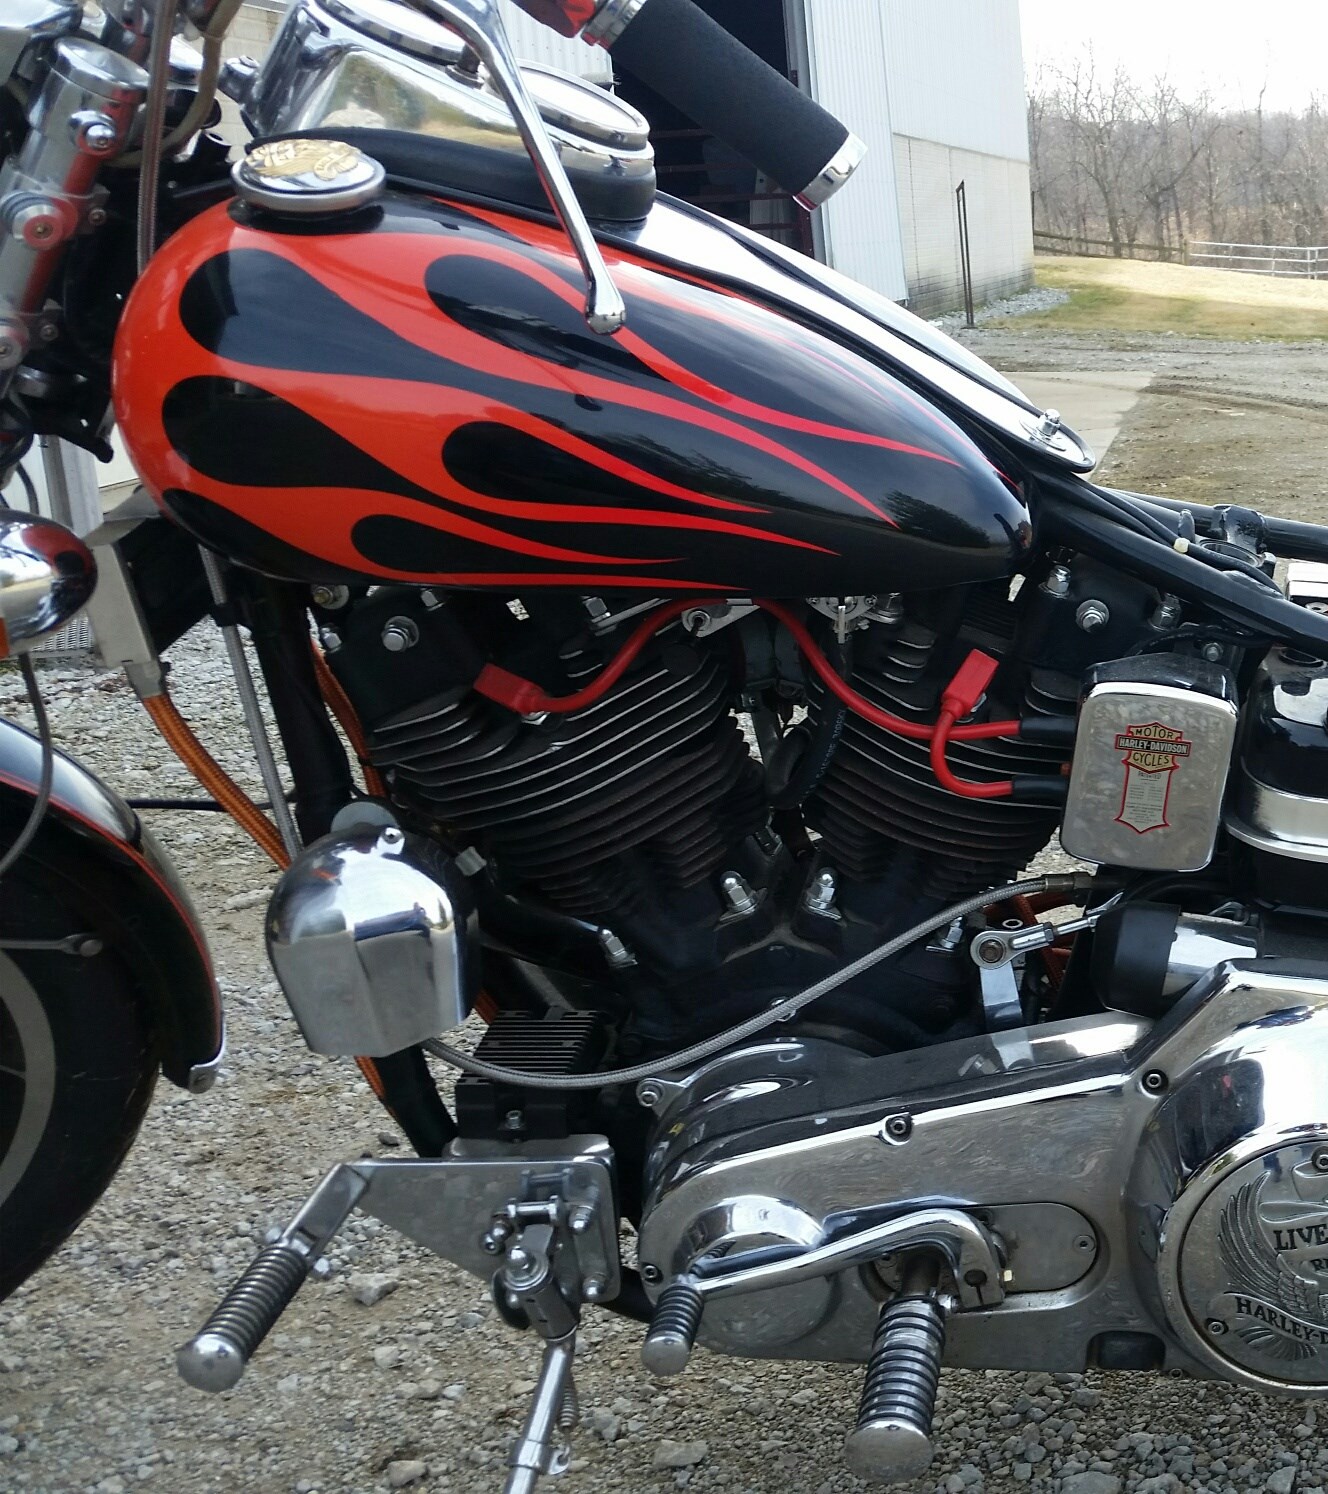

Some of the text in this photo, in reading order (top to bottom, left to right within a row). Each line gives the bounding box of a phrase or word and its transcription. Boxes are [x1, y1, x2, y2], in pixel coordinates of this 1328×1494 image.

[1135, 725, 1174, 740] MOTOR
[1119, 738, 1188, 754] HARLEY-DAVIDSON
[1132, 752, 1170, 767] CYCLES
[1273, 1223, 1328, 1252] LIVE
